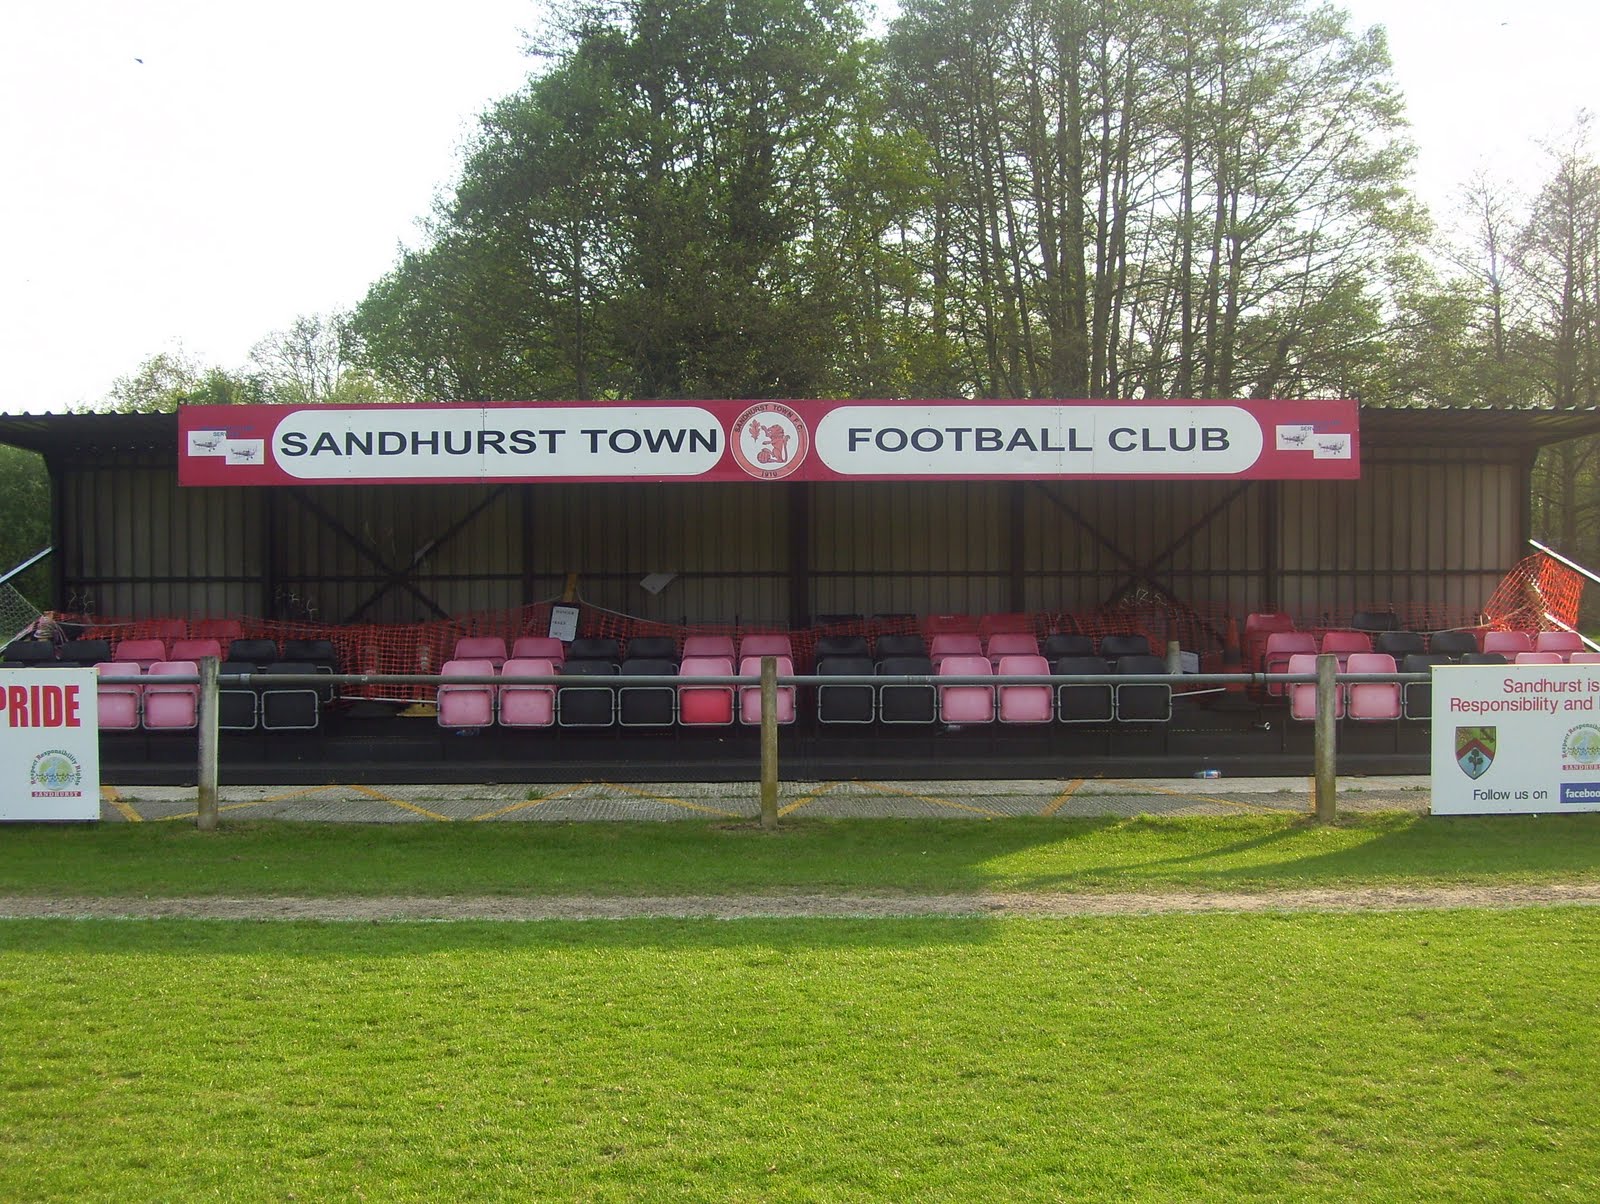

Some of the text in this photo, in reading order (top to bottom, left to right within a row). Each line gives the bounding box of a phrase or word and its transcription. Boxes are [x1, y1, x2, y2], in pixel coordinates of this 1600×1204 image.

[734, 404, 768, 432] SANDHURST
[773, 404, 794, 418] TOWN
[280, 428, 718, 456] SANDHURST TOWN
[848, 427, 1231, 452] FOOTBALL CLUB
[1503, 677, 1600, 693] Sandhurst is
[1450, 696, 1558, 716] Responsibility
[1563, 696, 1593, 711] and
[36, 749, 78, 766] Responsibility
[1473, 788, 1548, 800] Follow us on
